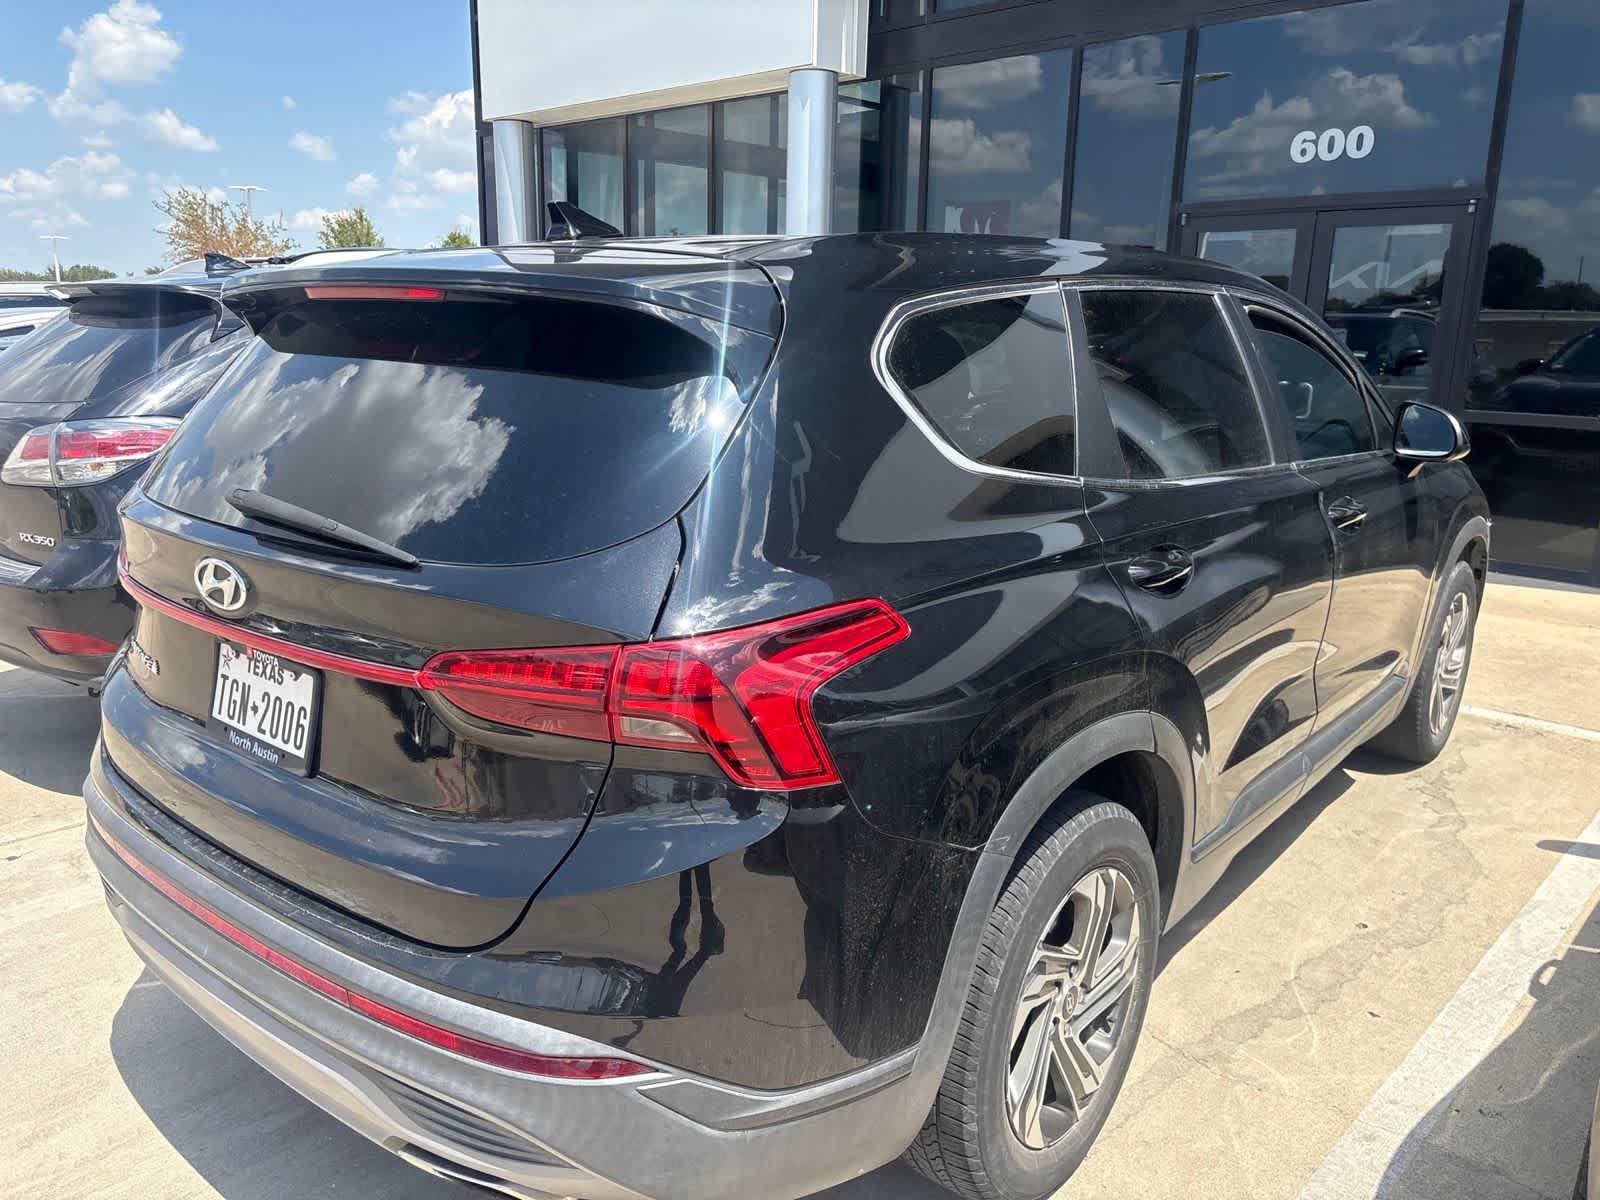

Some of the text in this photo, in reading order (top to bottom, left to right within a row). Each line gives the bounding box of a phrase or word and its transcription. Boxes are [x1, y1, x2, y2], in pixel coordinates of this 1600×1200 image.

[1290, 125, 1375, 164] 600
[247, 657, 285, 686] TEXAS
[253, 649, 280, 667] TOYOTA
[218, 673, 307, 751] TGN 2006
[228, 730, 279, 765] North Austin
